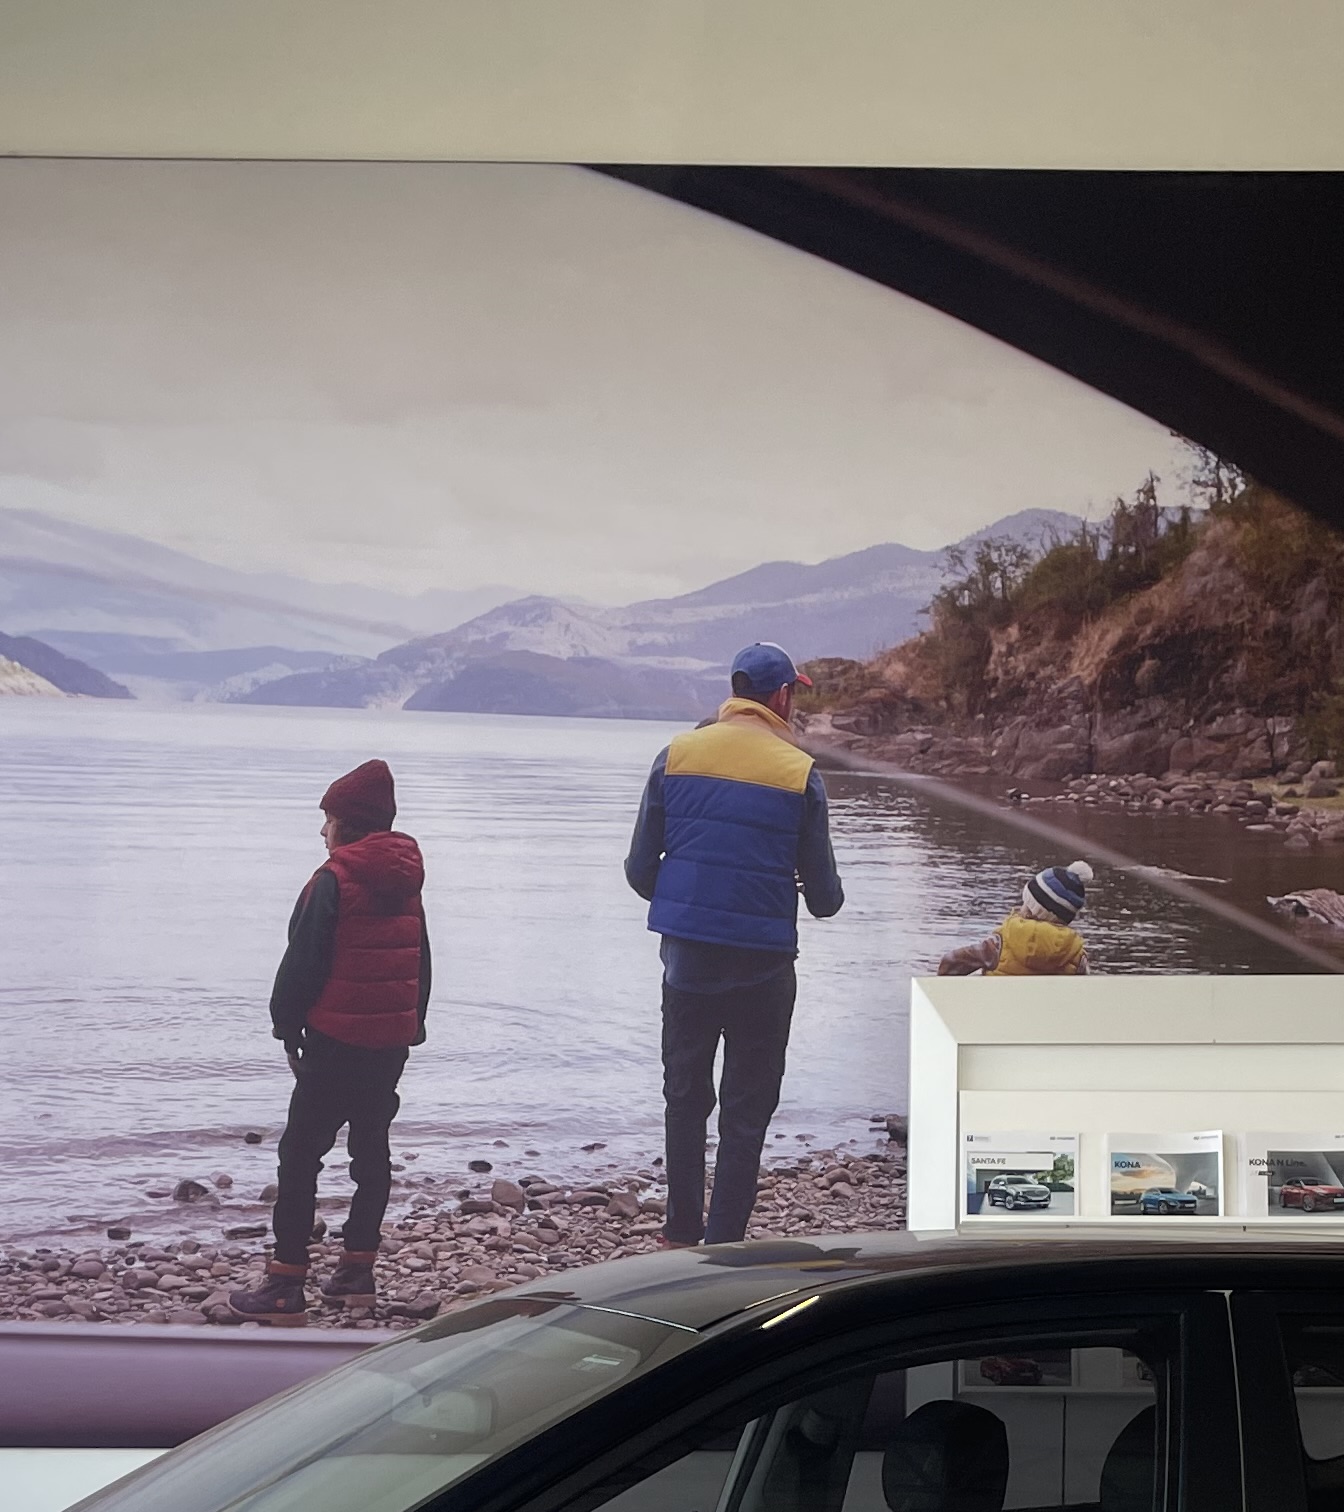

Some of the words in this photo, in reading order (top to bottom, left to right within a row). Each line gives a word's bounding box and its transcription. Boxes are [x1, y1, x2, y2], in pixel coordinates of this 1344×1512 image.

[971, 1157, 996, 1165] SANTA
[997, 1157, 1006, 1165] FE
[1249, 1158, 1276, 1166] KONA
